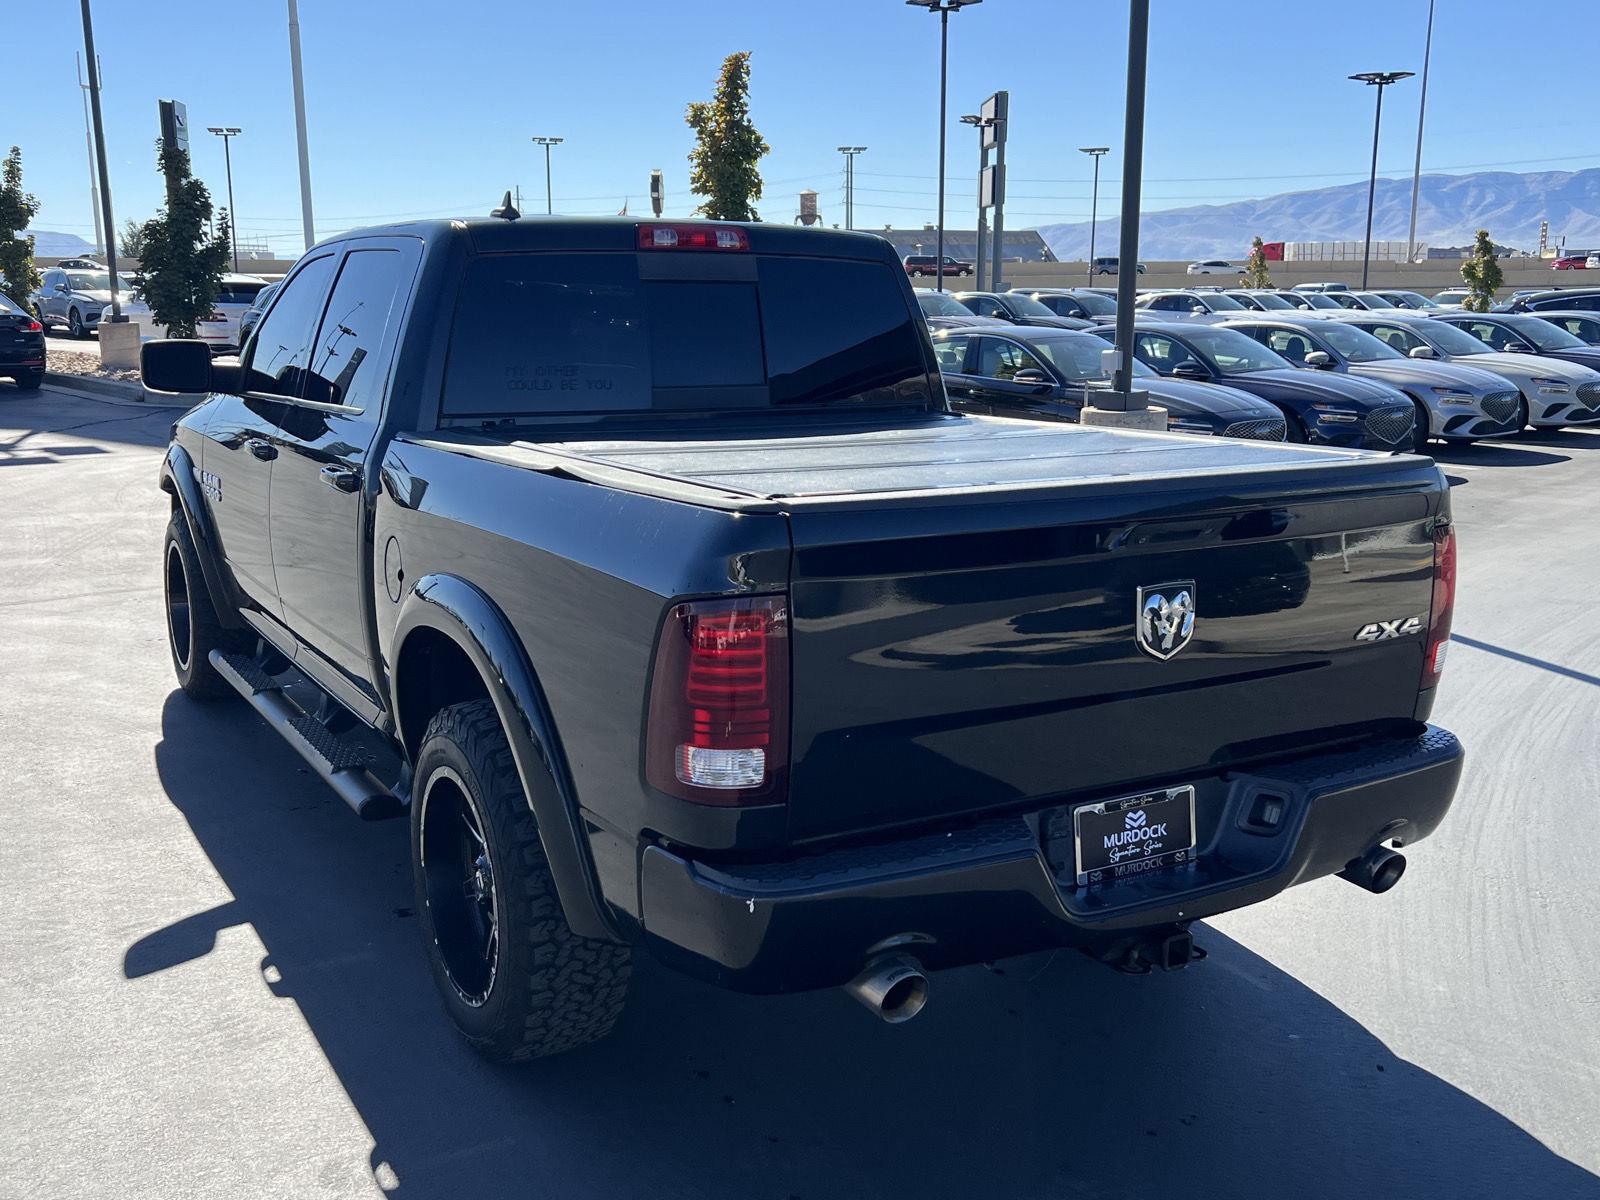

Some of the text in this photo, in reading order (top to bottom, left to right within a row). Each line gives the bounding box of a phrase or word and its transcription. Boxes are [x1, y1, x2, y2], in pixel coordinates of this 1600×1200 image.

[506, 379, 613, 391] COULD BE YOU
[1103, 822, 1168, 849] MURDOCK
[1143, 840, 1163, 855] Series
[1115, 857, 1164, 877] MURDOCK
